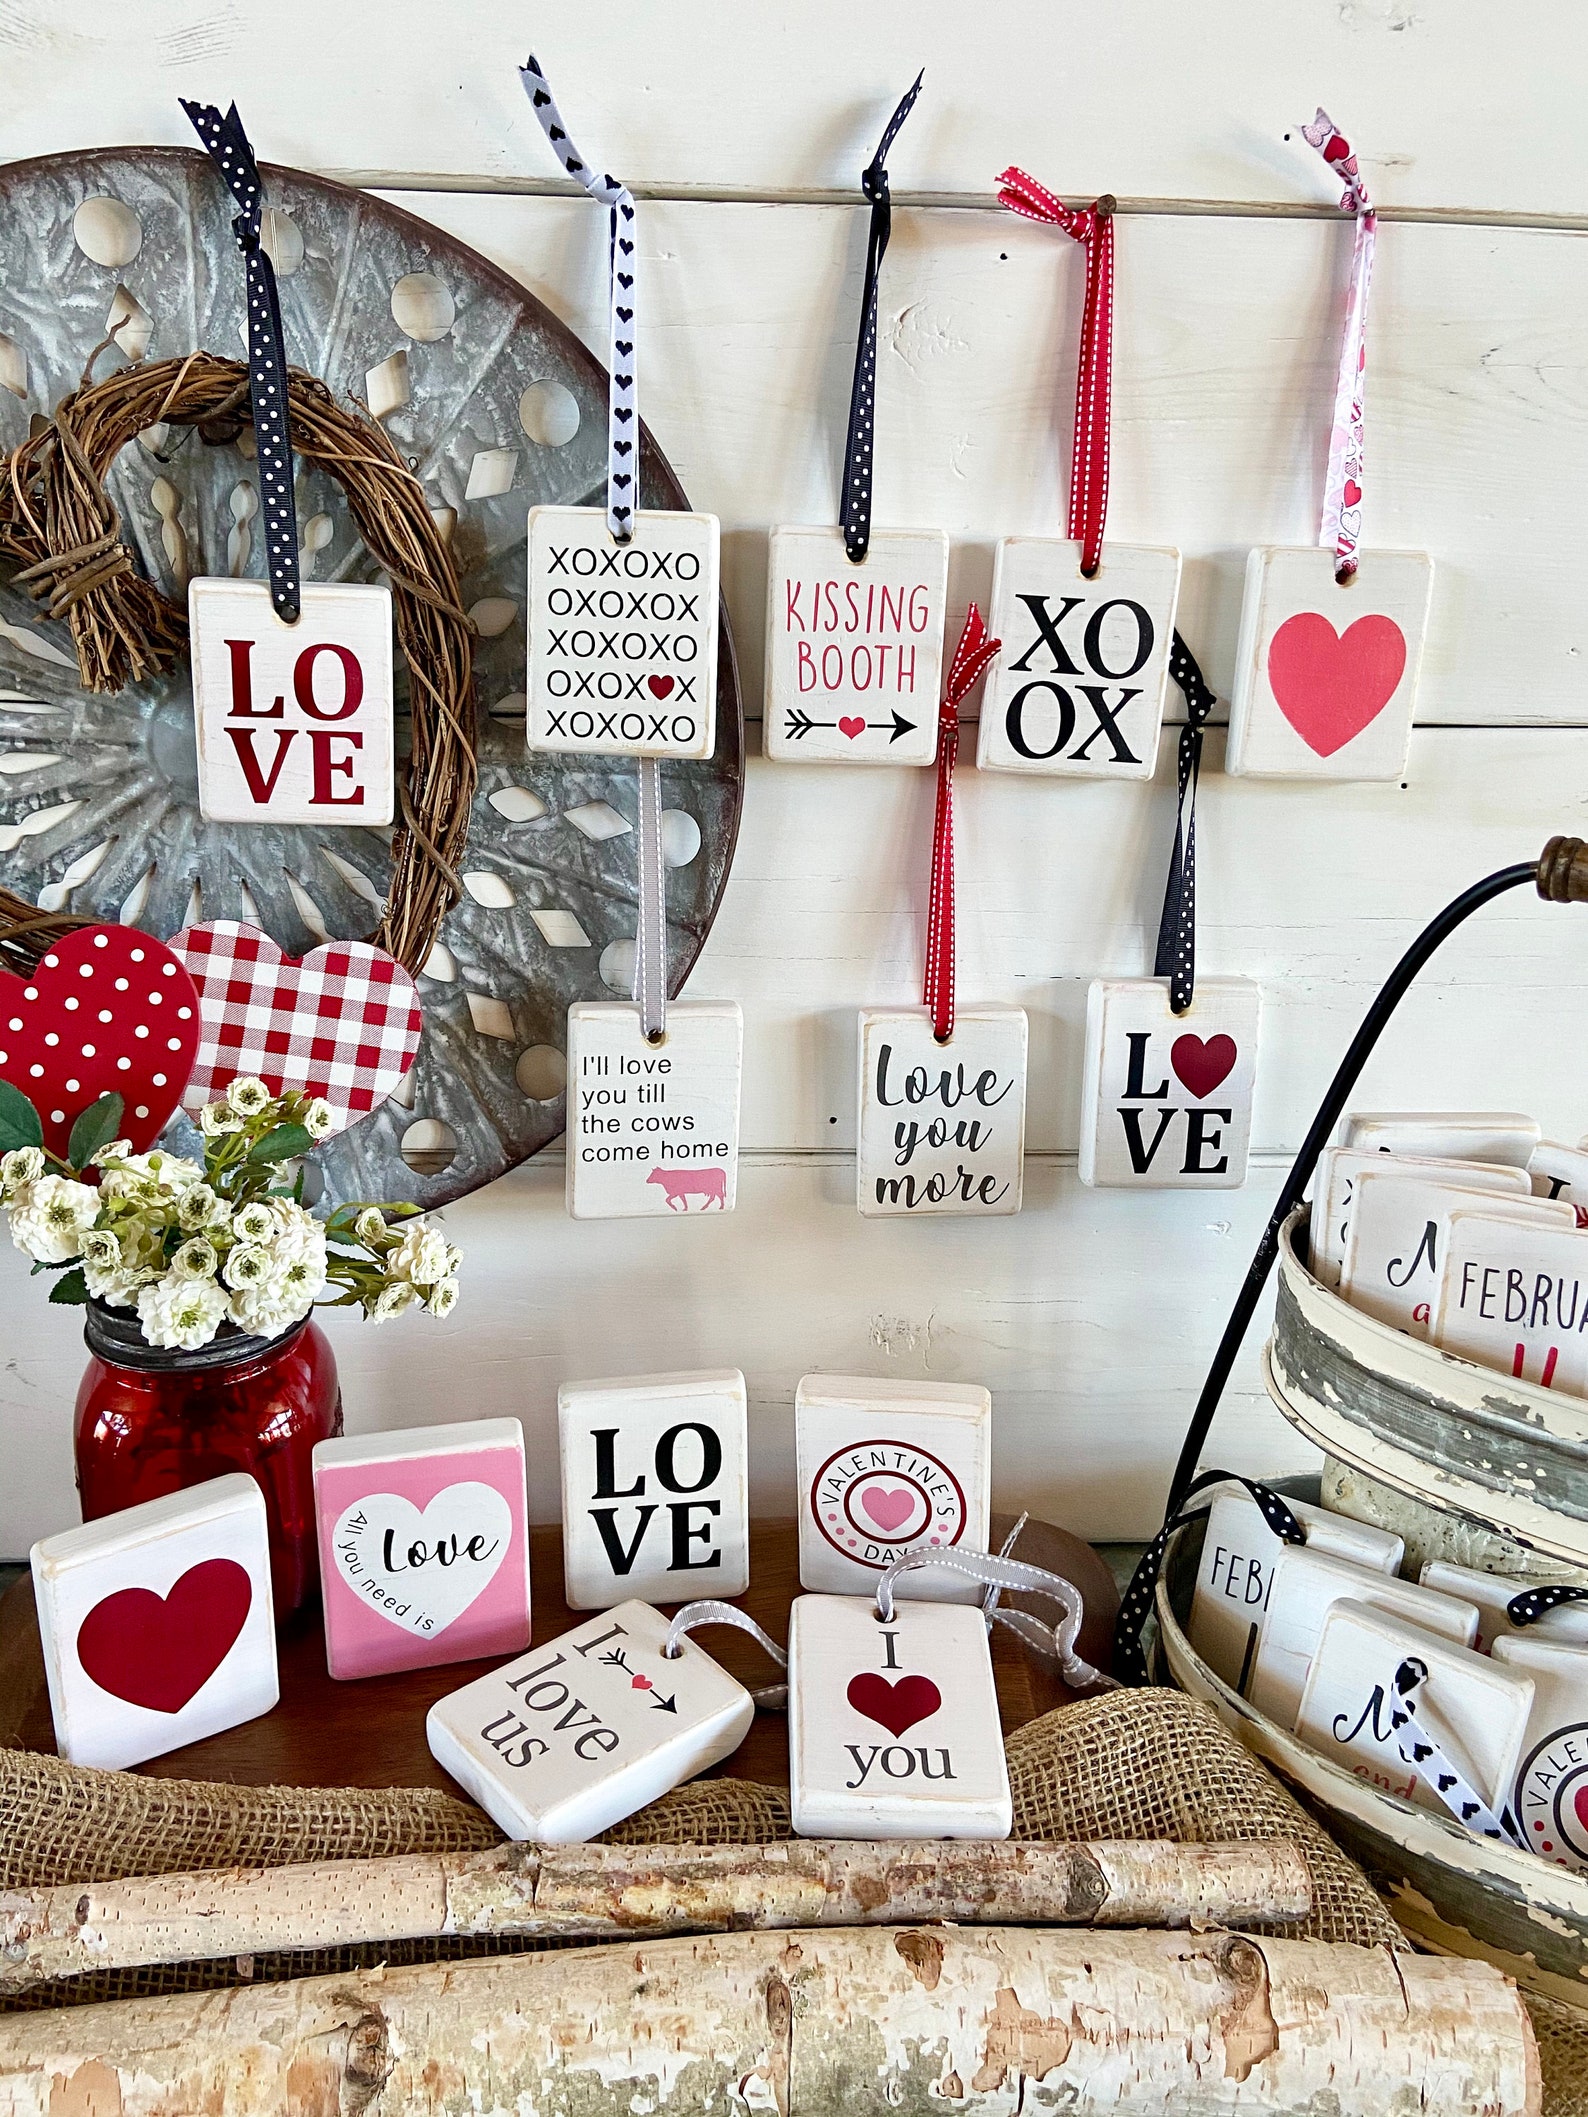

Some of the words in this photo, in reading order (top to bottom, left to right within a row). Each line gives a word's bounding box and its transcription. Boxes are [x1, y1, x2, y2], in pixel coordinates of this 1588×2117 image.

[547, 547, 701, 580] XOXOXO
[547, 588, 700, 622] OXOXOX
[786, 578, 929, 634] KISSING
[546, 629, 699, 663] XOXOXO
[1008, 593, 1155, 680] XO
[223, 639, 364, 722] LO
[798, 640, 916, 693] BOOTH
[545, 710, 697, 743] XOXOXO
[1005, 680, 1145, 764] OX
[223, 727, 365, 806] VE
[582, 1056, 609, 1076] I'll
[619, 1055, 672, 1075] love
[876, 1043, 1014, 1107] Love
[581, 1090, 627, 1110] you
[637, 1083, 666, 1104] till
[581, 1114, 621, 1134] the
[631, 1115, 695, 1132] cows
[894, 1116, 993, 1166] you
[1116, 1107, 1233, 1175] VE
[581, 1146, 650, 1163] come
[660, 1140, 729, 1160] home
[875, 1164, 1010, 1208] more
[589, 1422, 723, 1500] LO
[821, 1451, 956, 1516] VALENTINE'S
[345, 1510, 368, 1535] All
[587, 1500, 722, 1576] VE
[337, 1541, 364, 1575] you
[383, 1527, 499, 1573] Love
[361, 1579, 412, 1617] need
[1211, 1546, 1276, 1613] FEB
[414, 1612, 434, 1631] is
[572, 1623, 629, 1657] I
[878, 1630, 903, 1669] I
[505, 1653, 621, 1761] love
[480, 1710, 551, 1768] us
[843, 1744, 958, 1789] you
